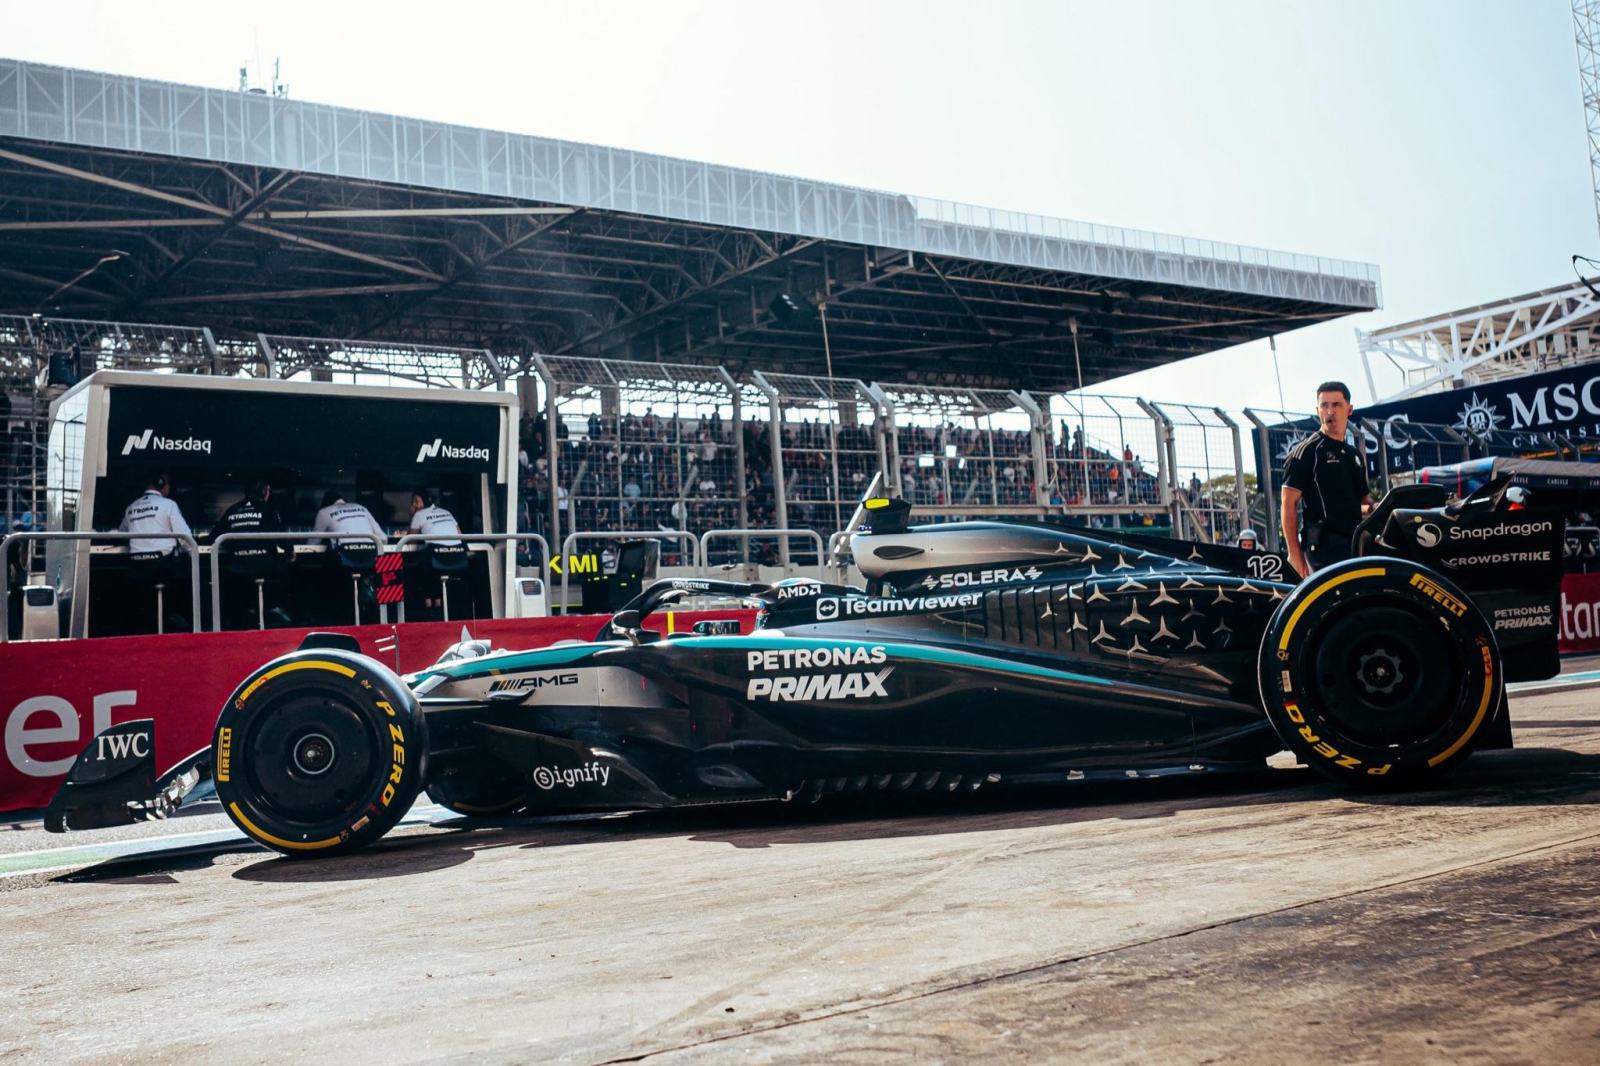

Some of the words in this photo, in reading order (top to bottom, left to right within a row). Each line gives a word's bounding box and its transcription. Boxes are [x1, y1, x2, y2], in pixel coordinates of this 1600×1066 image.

[1506, 377, 1600, 430] MSC
[1345, 413, 1409, 455] SC
[153, 436, 211, 454] Nasdaq
[442, 445, 489, 462] Nasdaq
[228, 512, 262, 521] PETRONAS
[1450, 521, 1552, 540] Snapdragon
[549, 554, 598, 574] KMI
[1247, 554, 1283, 582] 12
[1449, 551, 1551, 567] CROWDSTRIKE
[939, 568, 1026, 588] SOLERA
[778, 585, 809, 599] AMD
[1409, 572, 1468, 617] PIRELLI
[841, 592, 983, 615] TeamViewer
[1494, 605, 1551, 618] PETRONAS
[1494, 615, 1552, 630] PRIMAX
[747, 646, 887, 671] PETRONAS
[518, 674, 578, 689] AMG
[747, 669, 890, 702] PRIMAX
[376, 701, 396, 717] P
[1284, 701, 1362, 769] ZERO
[97, 732, 149, 760] IWC
[217, 727, 232, 781] PIRELLI
[381, 723, 405, 807] ZERO
